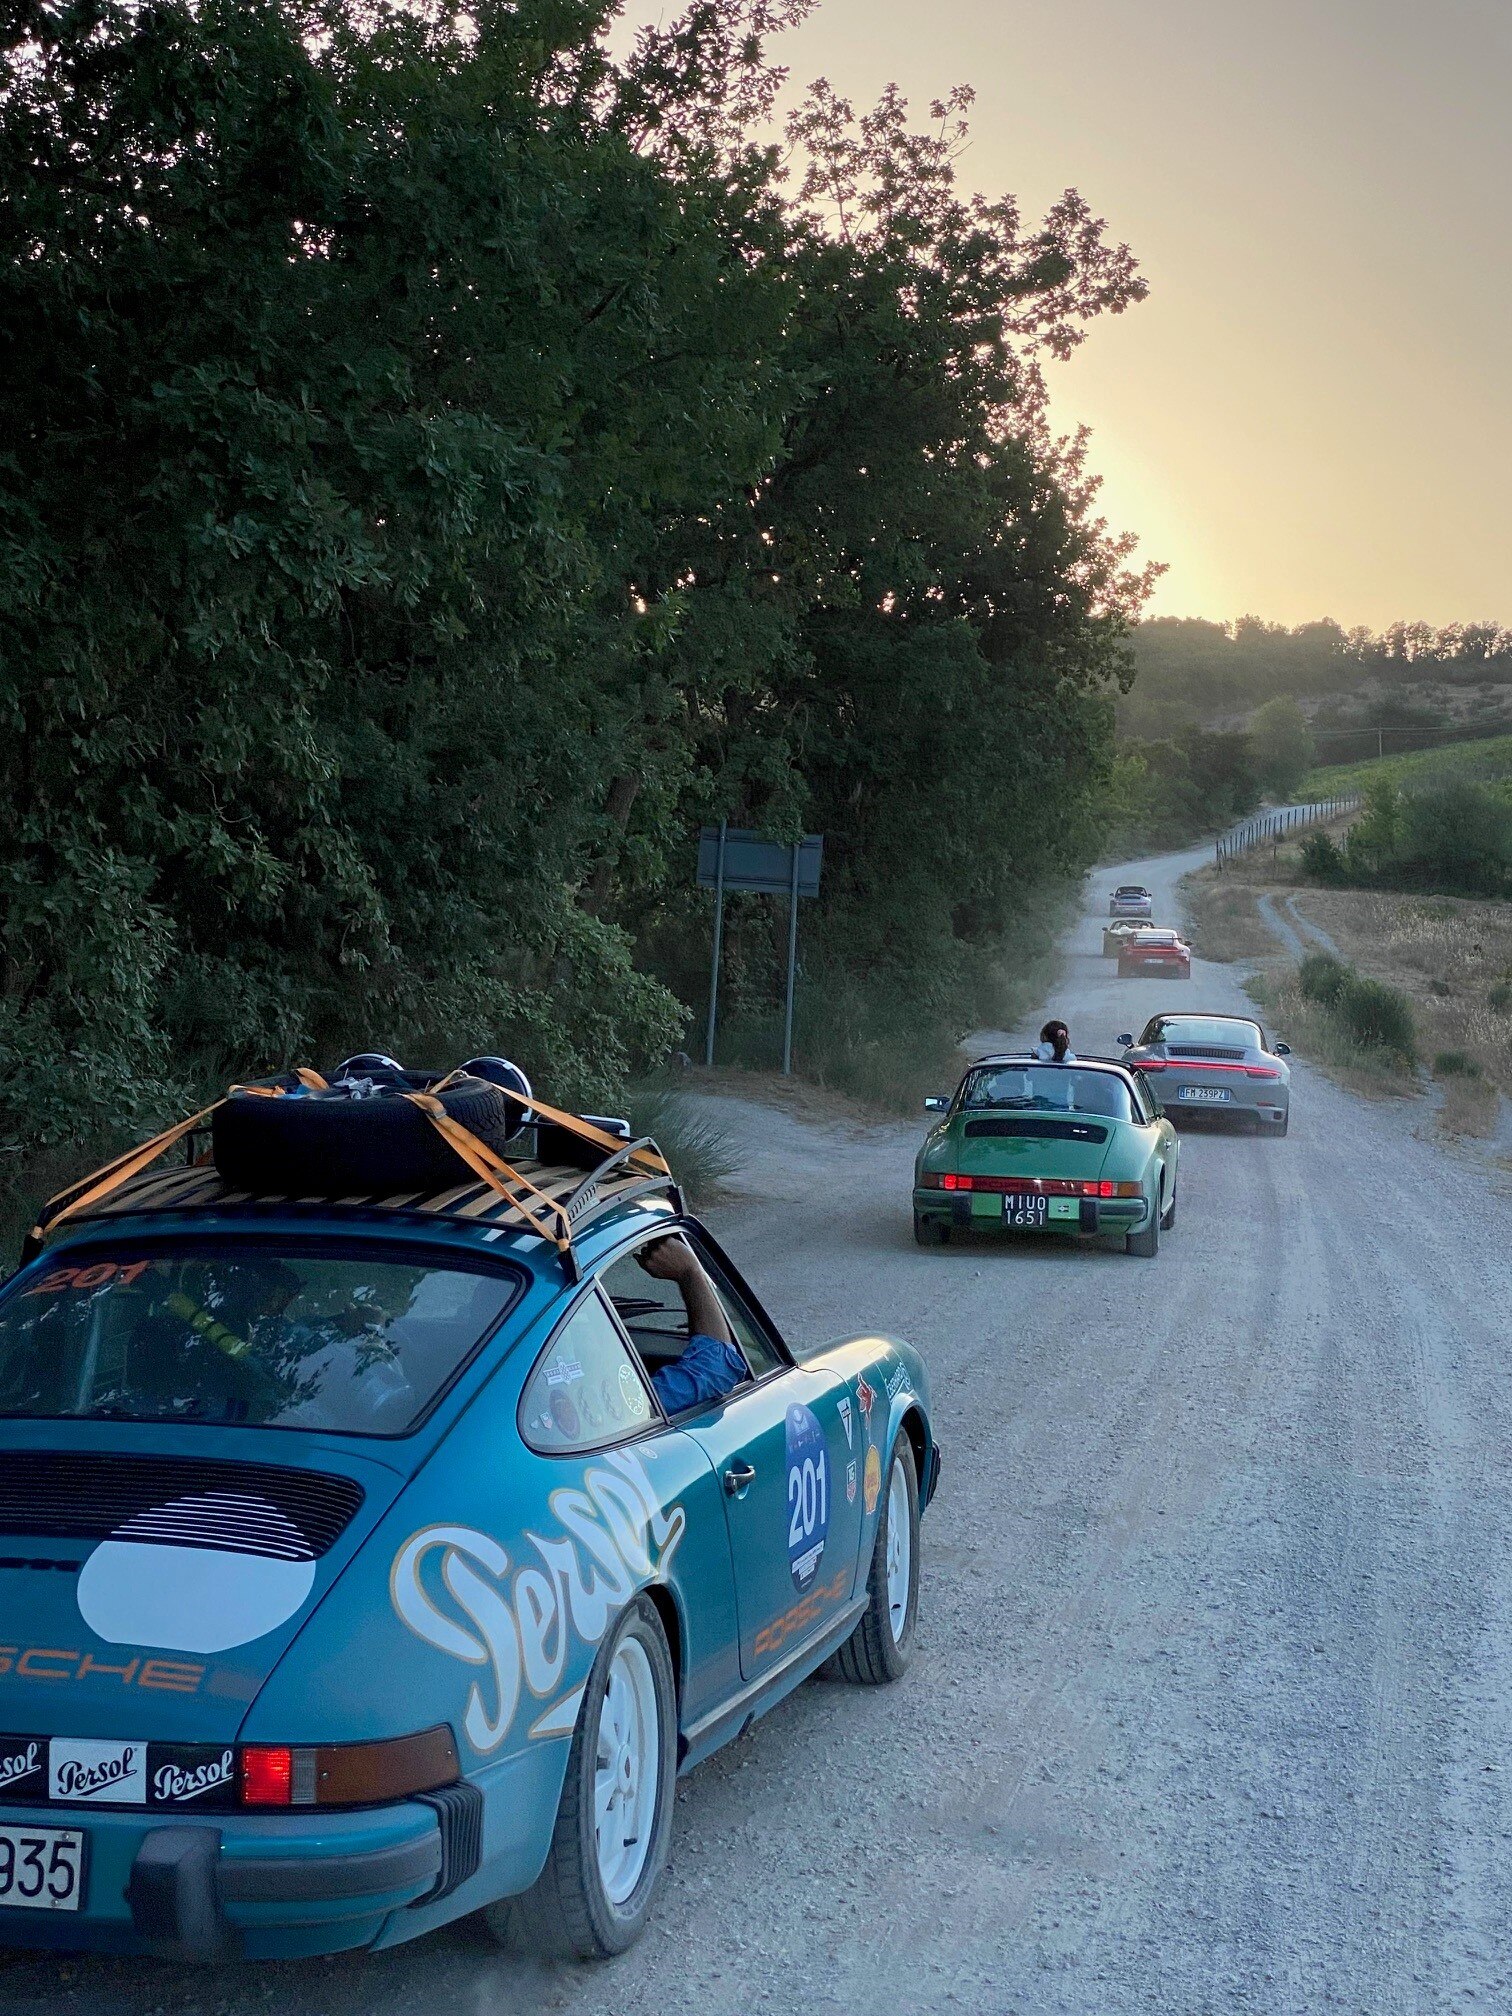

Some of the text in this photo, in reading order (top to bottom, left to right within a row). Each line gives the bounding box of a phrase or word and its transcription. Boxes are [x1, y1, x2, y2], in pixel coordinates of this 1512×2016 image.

[1006, 1210, 1043, 1225] 1651
[25, 1260, 149, 1297] 201
[788, 1449, 826, 1547] 201
[0, 1646, 206, 1693] CHE
[0, 1742, 234, 1801] sol Persol Persol
[0, 1837, 76, 1900] 935
